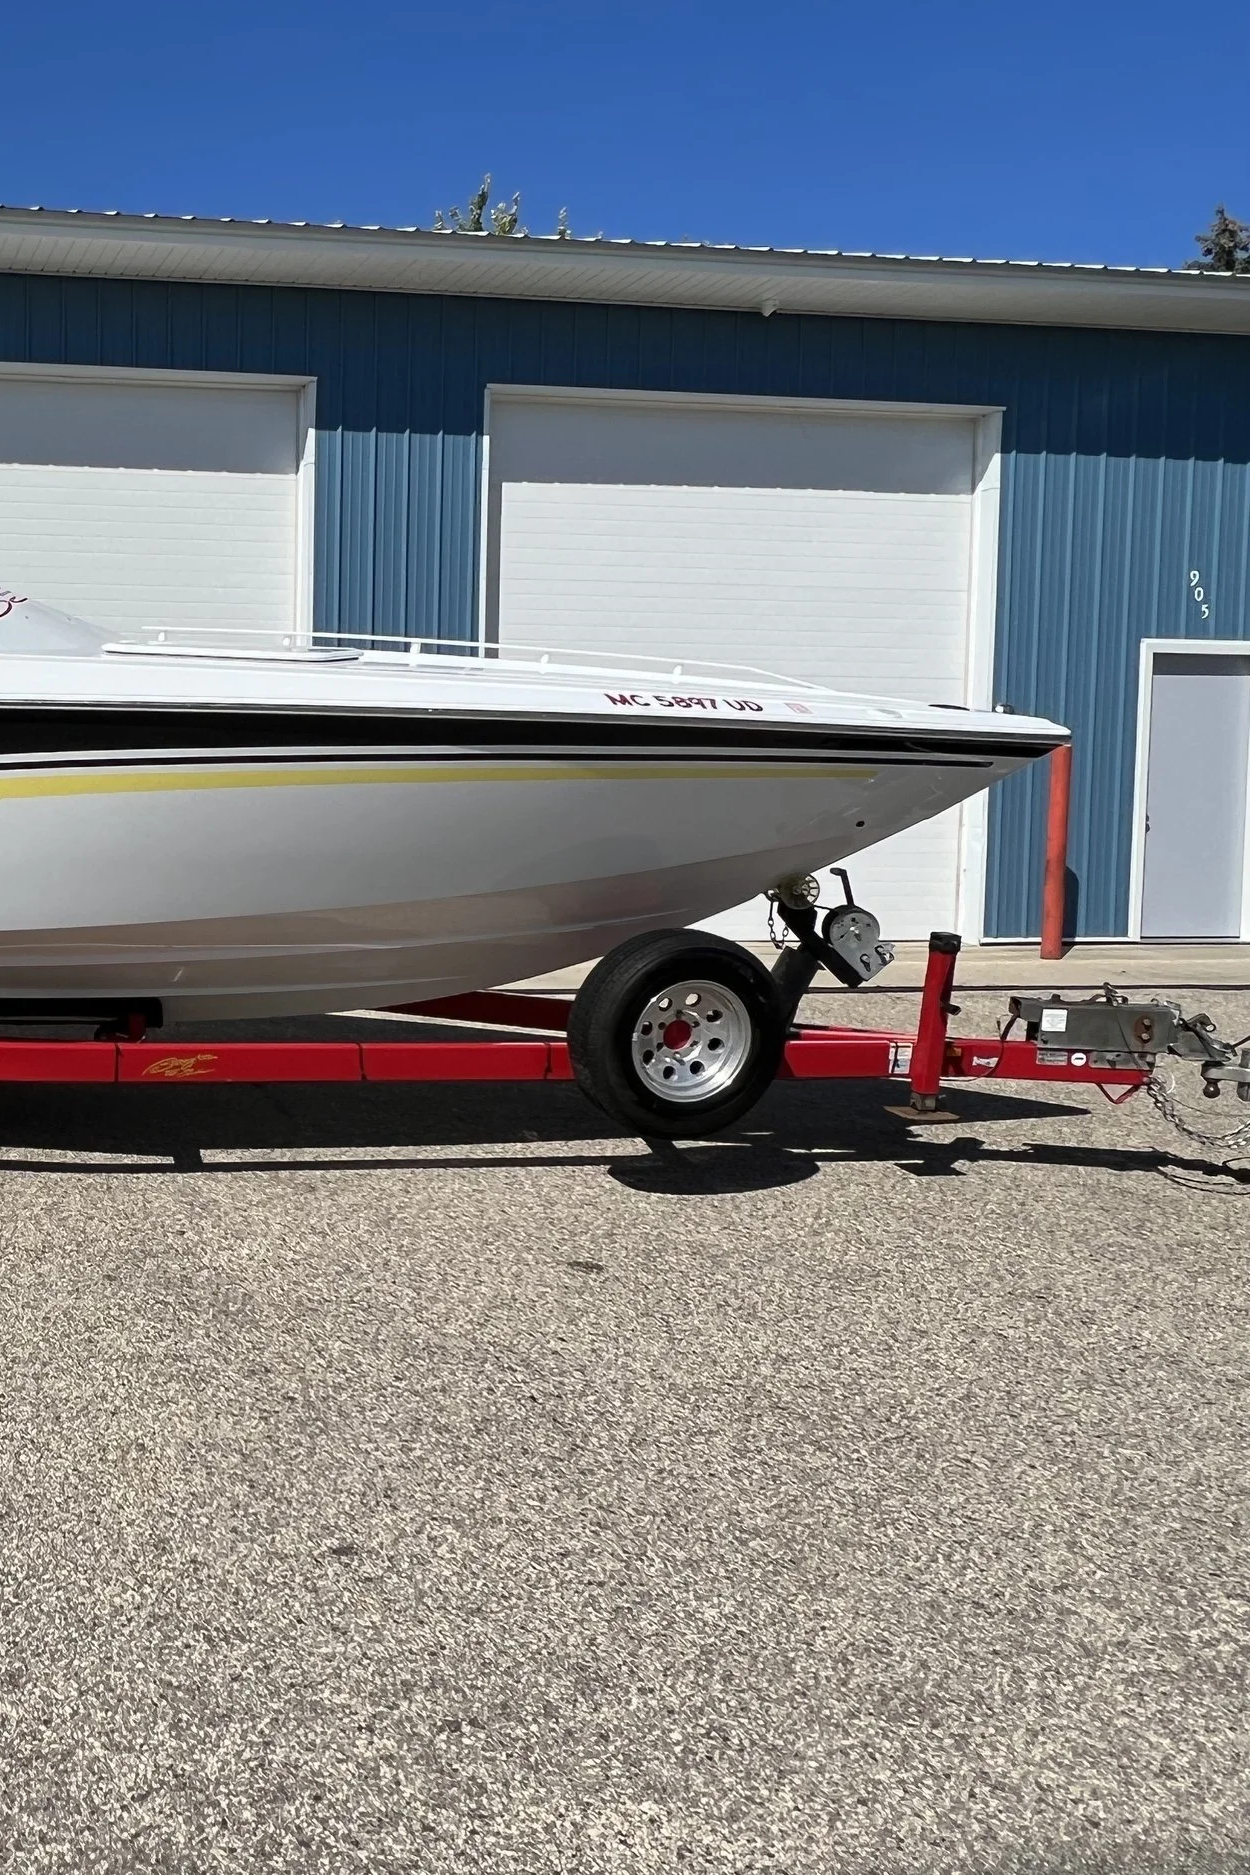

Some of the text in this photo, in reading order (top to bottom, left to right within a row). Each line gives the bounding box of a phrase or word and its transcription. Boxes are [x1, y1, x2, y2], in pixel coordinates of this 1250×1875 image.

[1190, 570, 1209, 619] 905
[604, 693, 763, 712] MC 5897 UD
